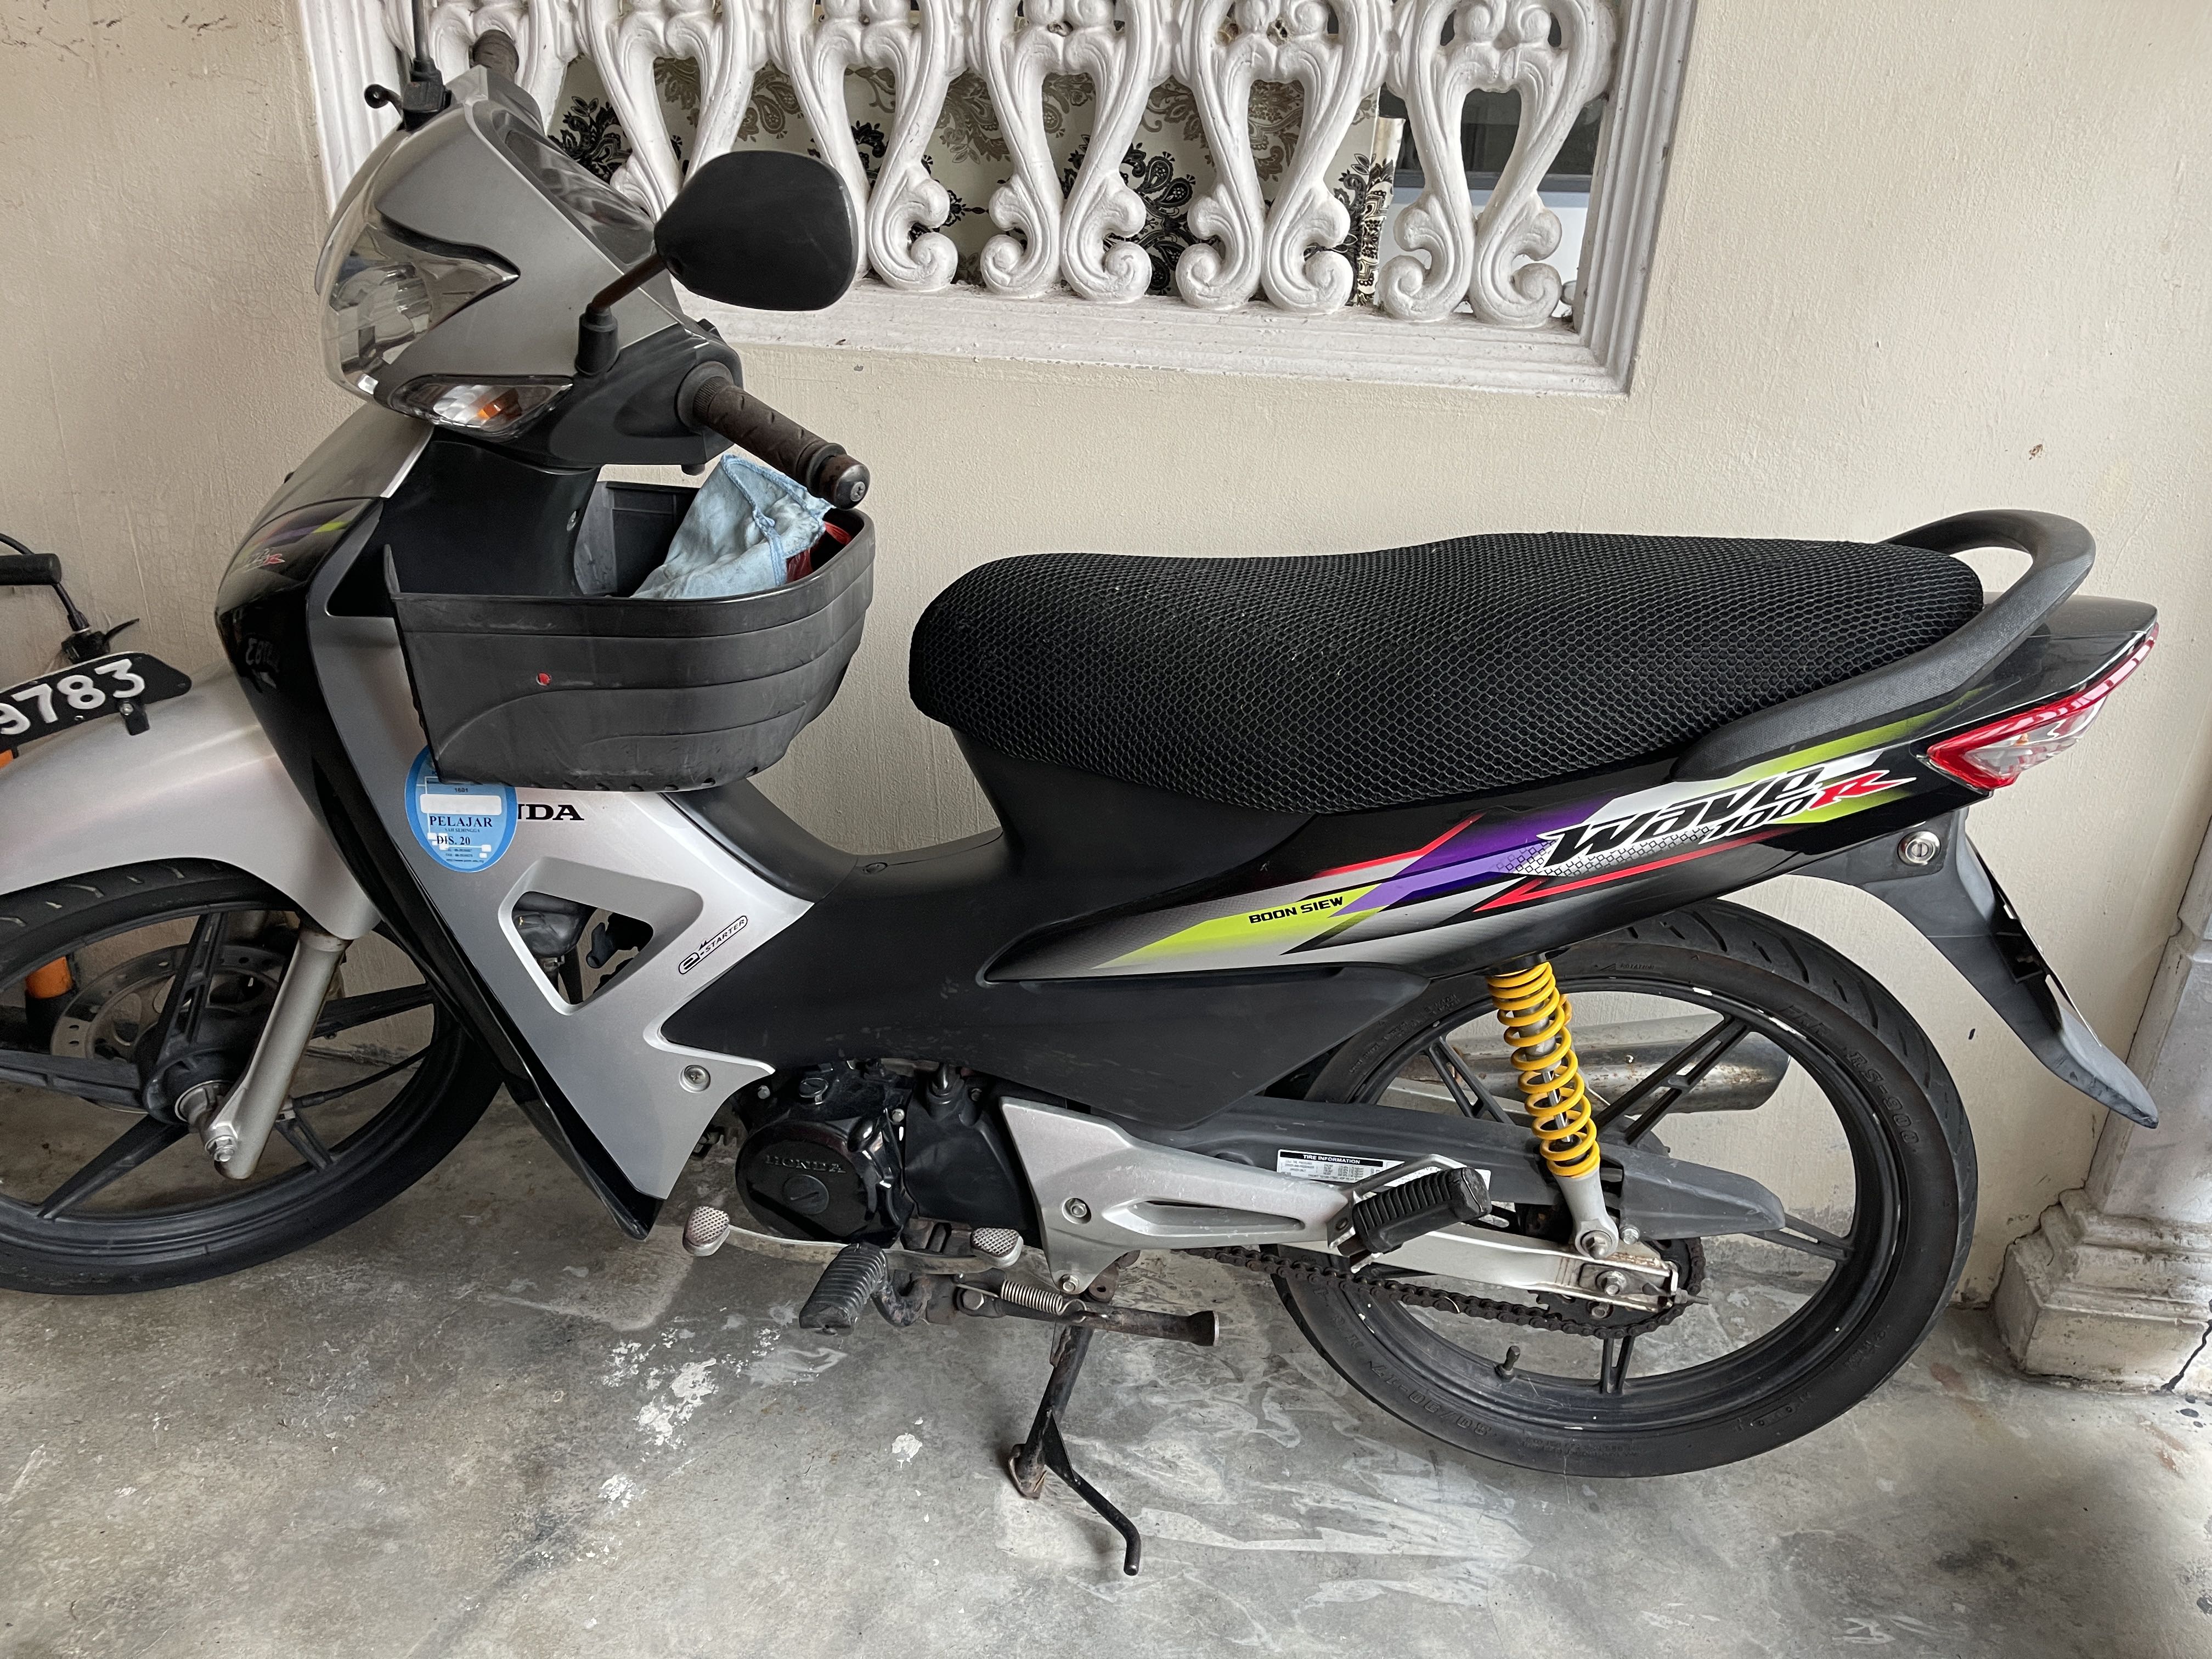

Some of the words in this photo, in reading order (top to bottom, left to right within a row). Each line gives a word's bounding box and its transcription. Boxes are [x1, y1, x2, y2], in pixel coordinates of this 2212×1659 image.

[0, 658, 145, 735] 9783
[518, 804, 584, 821] DA
[430, 816, 493, 827] PELAJAR
[437, 836, 457, 845] DIS.
[460, 836, 470, 845] 20
[1249, 907, 1297, 924] BOON
[1301, 896, 1343, 913] SIEW
[765, 1155, 847, 1173] HONDA
[1318, 1156, 1361, 1164] INFORMATION
